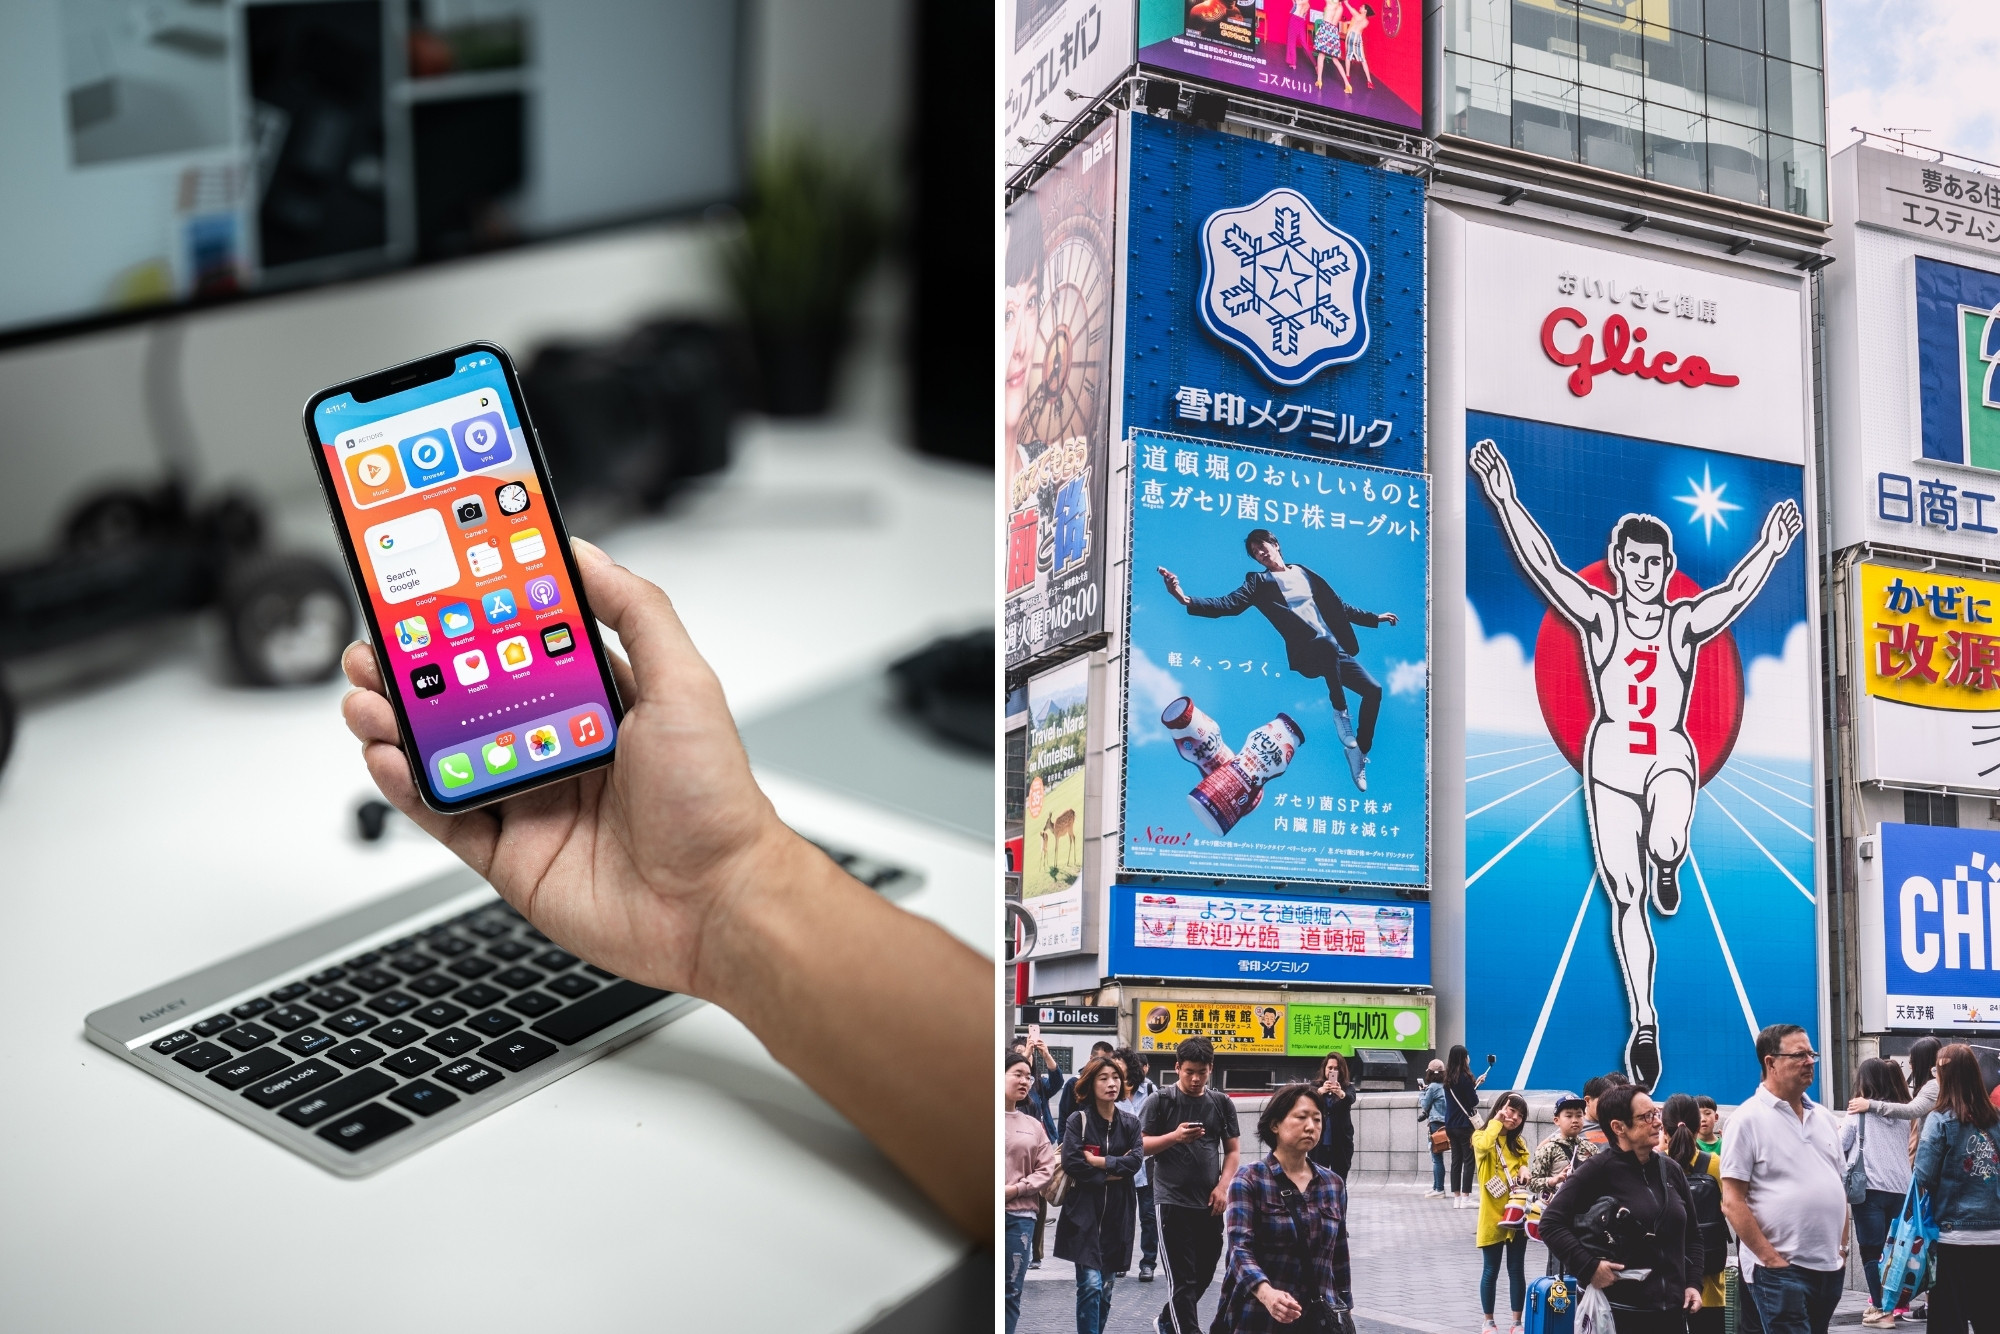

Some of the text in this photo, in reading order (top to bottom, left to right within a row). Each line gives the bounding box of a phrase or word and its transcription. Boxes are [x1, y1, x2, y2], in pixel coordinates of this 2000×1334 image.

[1258, 72, 1312, 94] コスパいい
[1557, 270, 1718, 324] おいしさと健康
[1540, 306, 1740, 397] Glico
[325, 403, 341, 415] 4:11
[1175, 385, 1393, 448] 雪印メグミルク
[358, 431, 384, 444] ACTIONS
[480, 454, 494, 463] VPN
[422, 469, 446, 482] Browser
[1141, 444, 1421, 509] 道頓堀のおいしいものと
[372, 487, 390, 497] Music
[422, 485, 457, 501] Documents
[1877, 471, 1999, 534] 日商工
[510, 514, 528, 525] Clock
[464, 527, 488, 539] Camera
[491, 537, 498, 546] 3
[525, 562, 544, 572] Notes
[386, 567, 417, 583] Search
[475, 573, 508, 588] Reminders
[389, 578, 421, 594] Google
[415, 595, 437, 607] Google
[1883, 577, 1993, 624] かぜに
[535, 608, 564, 621] Podcasts
[491, 621, 522, 635] App Store
[450, 635, 476, 648] Weather
[410, 650, 429, 660] Maps
[554, 655, 575, 667] Wallet
[1872, 621, 2000, 691] 改源
[1167, 651, 1283, 679] 軽々、つづく。
[512, 670, 531, 680] Home
[467, 683, 489, 694] Health
[429, 698, 440, 706] TV
[1623, 644, 1660, 756] グリコ
[1030, 713, 1085, 747] Travel to Nara
[498, 733, 514, 746] 237
[1029, 761, 1038, 773] on
[1273, 792, 1392, 814] ガセリ菌SP株が
[1273, 815, 1401, 839] 内臓脂肪を減らす
[1133, 825, 1192, 846] New!
[1199, 900, 1352, 926] ようこそ道頓堀へ
[1300, 925, 1366, 953] 道頓堀
[1238, 959, 1310, 974] 雪印メグミルク
[139, 999, 188, 1024] AUKEY
[1056, 1009, 1099, 1023] Toilets
[1176, 1008, 1252, 1023] 店舗情報館
[1895, 1005, 1935, 1021] 天気予報
[341, 1014, 357, 1024] W
[1333, 1010, 1389, 1041] ピタットハウス
[172, 1033, 189, 1042] Esc
[391, 1027, 403, 1035] S
[304, 1035, 330, 1050] Android
[445, 1035, 459, 1044] X
[349, 1047, 362, 1055] A
[508, 1043, 526, 1053] Alt
[403, 1056, 417, 1064] Z
[227, 1065, 250, 1076] Tab
[448, 1063, 472, 1075] Win
[466, 1068, 489, 1082] cmd
[262, 1068, 318, 1094] Caps Lock
[413, 1089, 433, 1100] Fn
[298, 1099, 328, 1115] Shift
